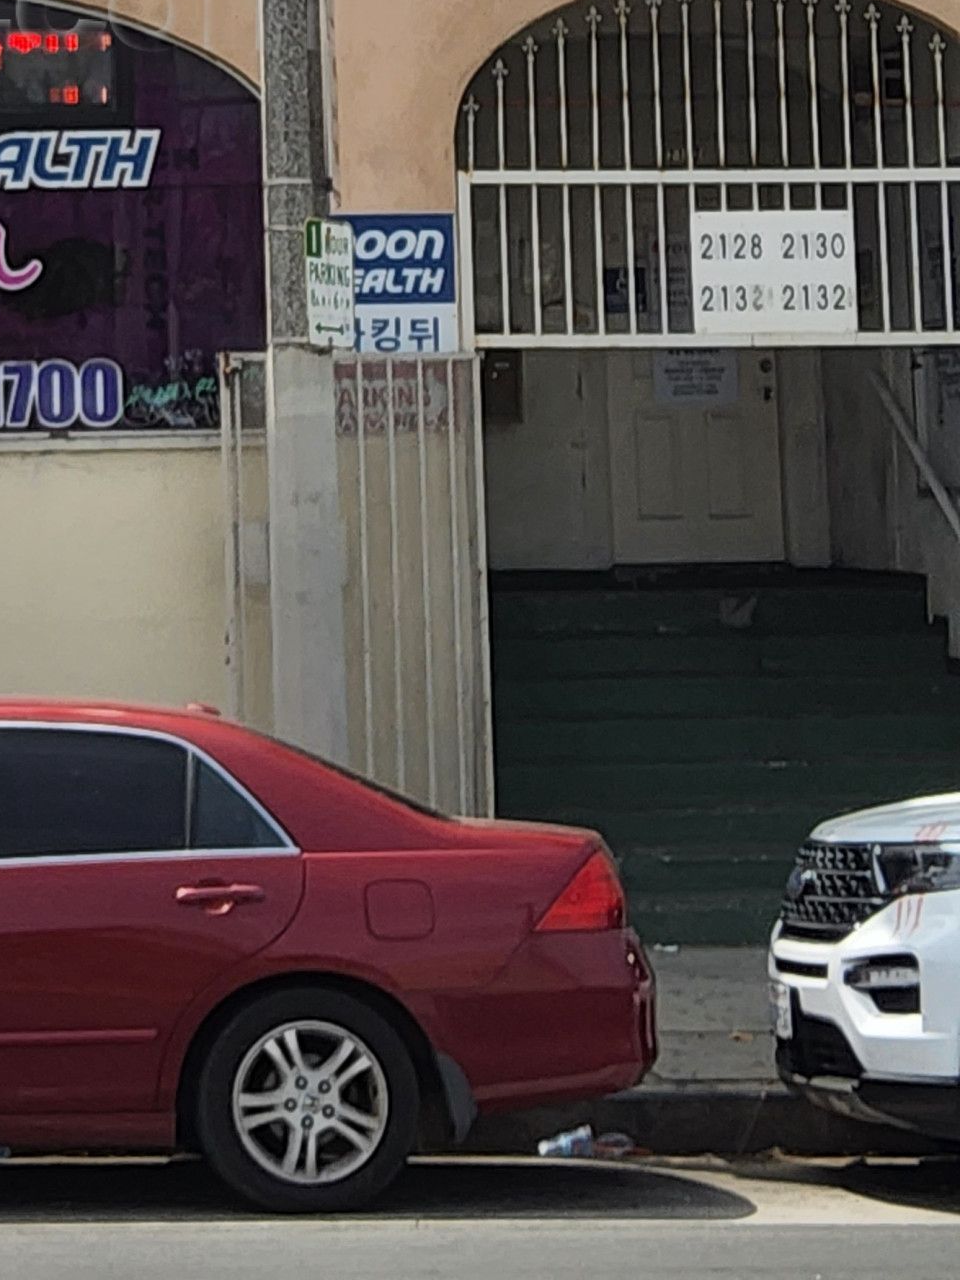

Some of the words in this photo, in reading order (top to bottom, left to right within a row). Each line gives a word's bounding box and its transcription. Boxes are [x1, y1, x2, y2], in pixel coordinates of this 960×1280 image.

[354, 229, 445, 260] OON
[700, 233, 763, 260] 2128
[781, 233, 846, 259] 2130
[309, 261, 350, 288] PARKING
[354, 268, 445, 295] EALTH
